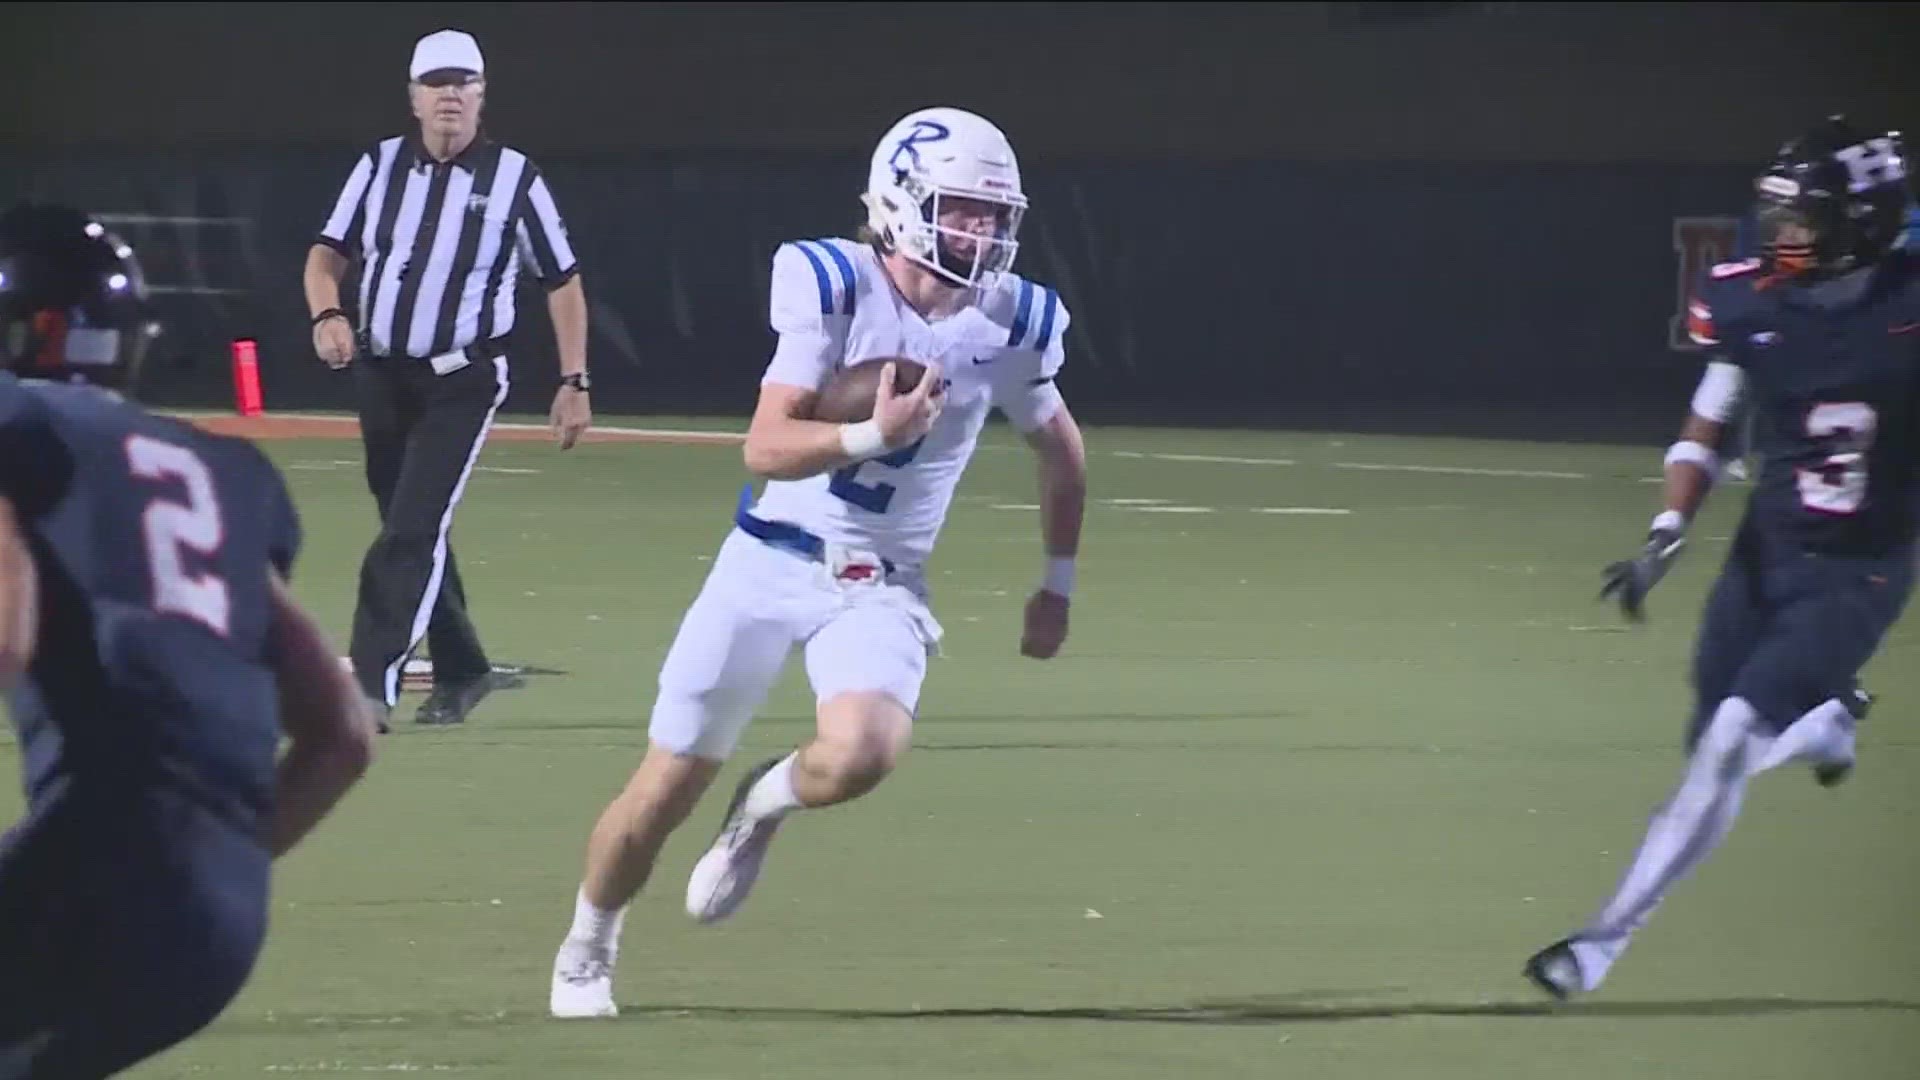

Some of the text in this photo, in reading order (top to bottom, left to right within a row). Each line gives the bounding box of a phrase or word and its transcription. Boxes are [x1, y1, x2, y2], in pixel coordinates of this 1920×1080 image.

[887, 120, 951, 176] R
[1834, 136, 1907, 194] H
[1796, 402, 1876, 514] 3
[125, 433, 230, 636] 2
